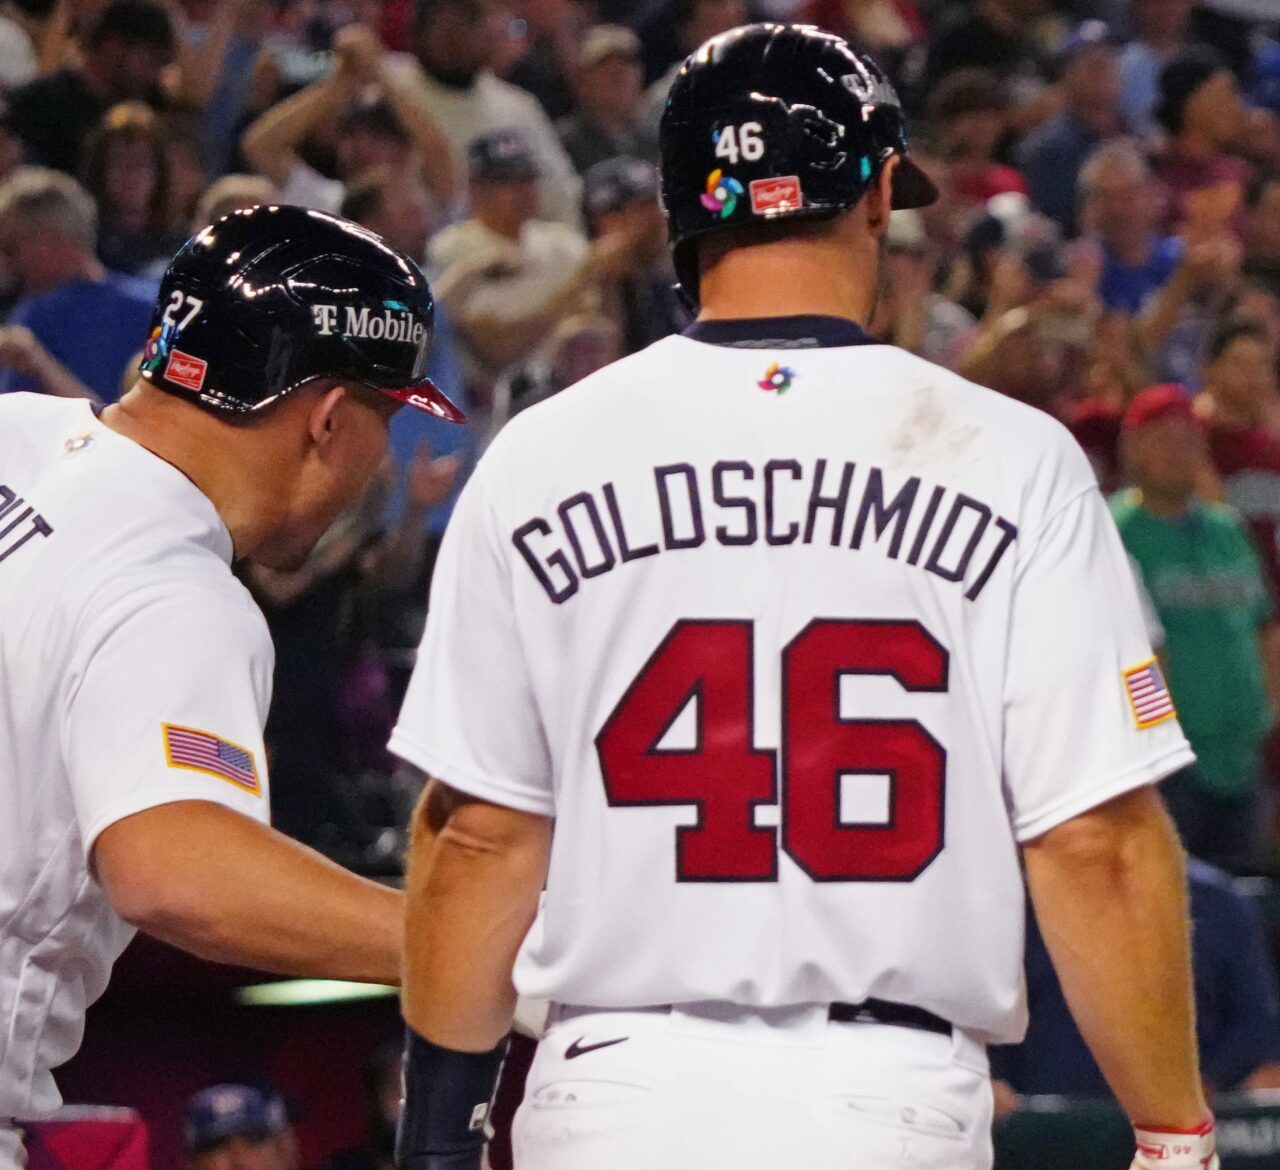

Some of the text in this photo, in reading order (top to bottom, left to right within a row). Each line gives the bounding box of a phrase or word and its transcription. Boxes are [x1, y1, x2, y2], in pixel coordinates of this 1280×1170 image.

[716, 121, 765, 165] 46
[162, 290, 204, 330] 27
[343, 305, 424, 344] Mobile
[512, 457, 1018, 605] GOLDSCHMIDT
[594, 616, 951, 884] 46
